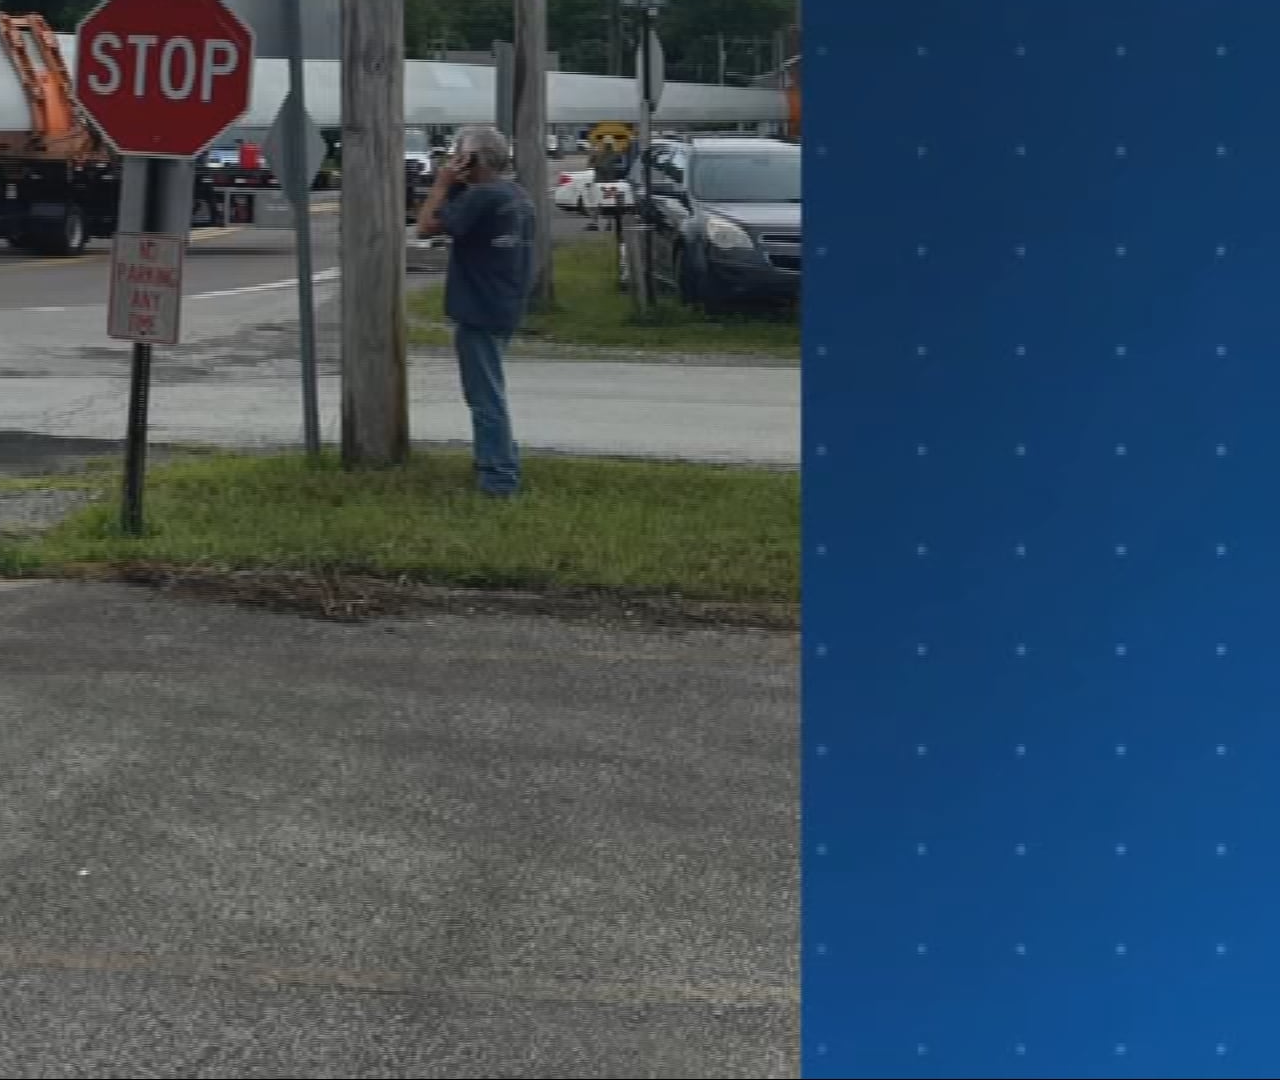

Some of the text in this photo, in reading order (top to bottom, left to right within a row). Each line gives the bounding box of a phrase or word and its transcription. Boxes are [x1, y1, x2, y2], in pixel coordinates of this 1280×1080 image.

[87, 31, 239, 102] STOP
[117, 262, 177, 288] PARKING
[129, 290, 161, 312] ANY
